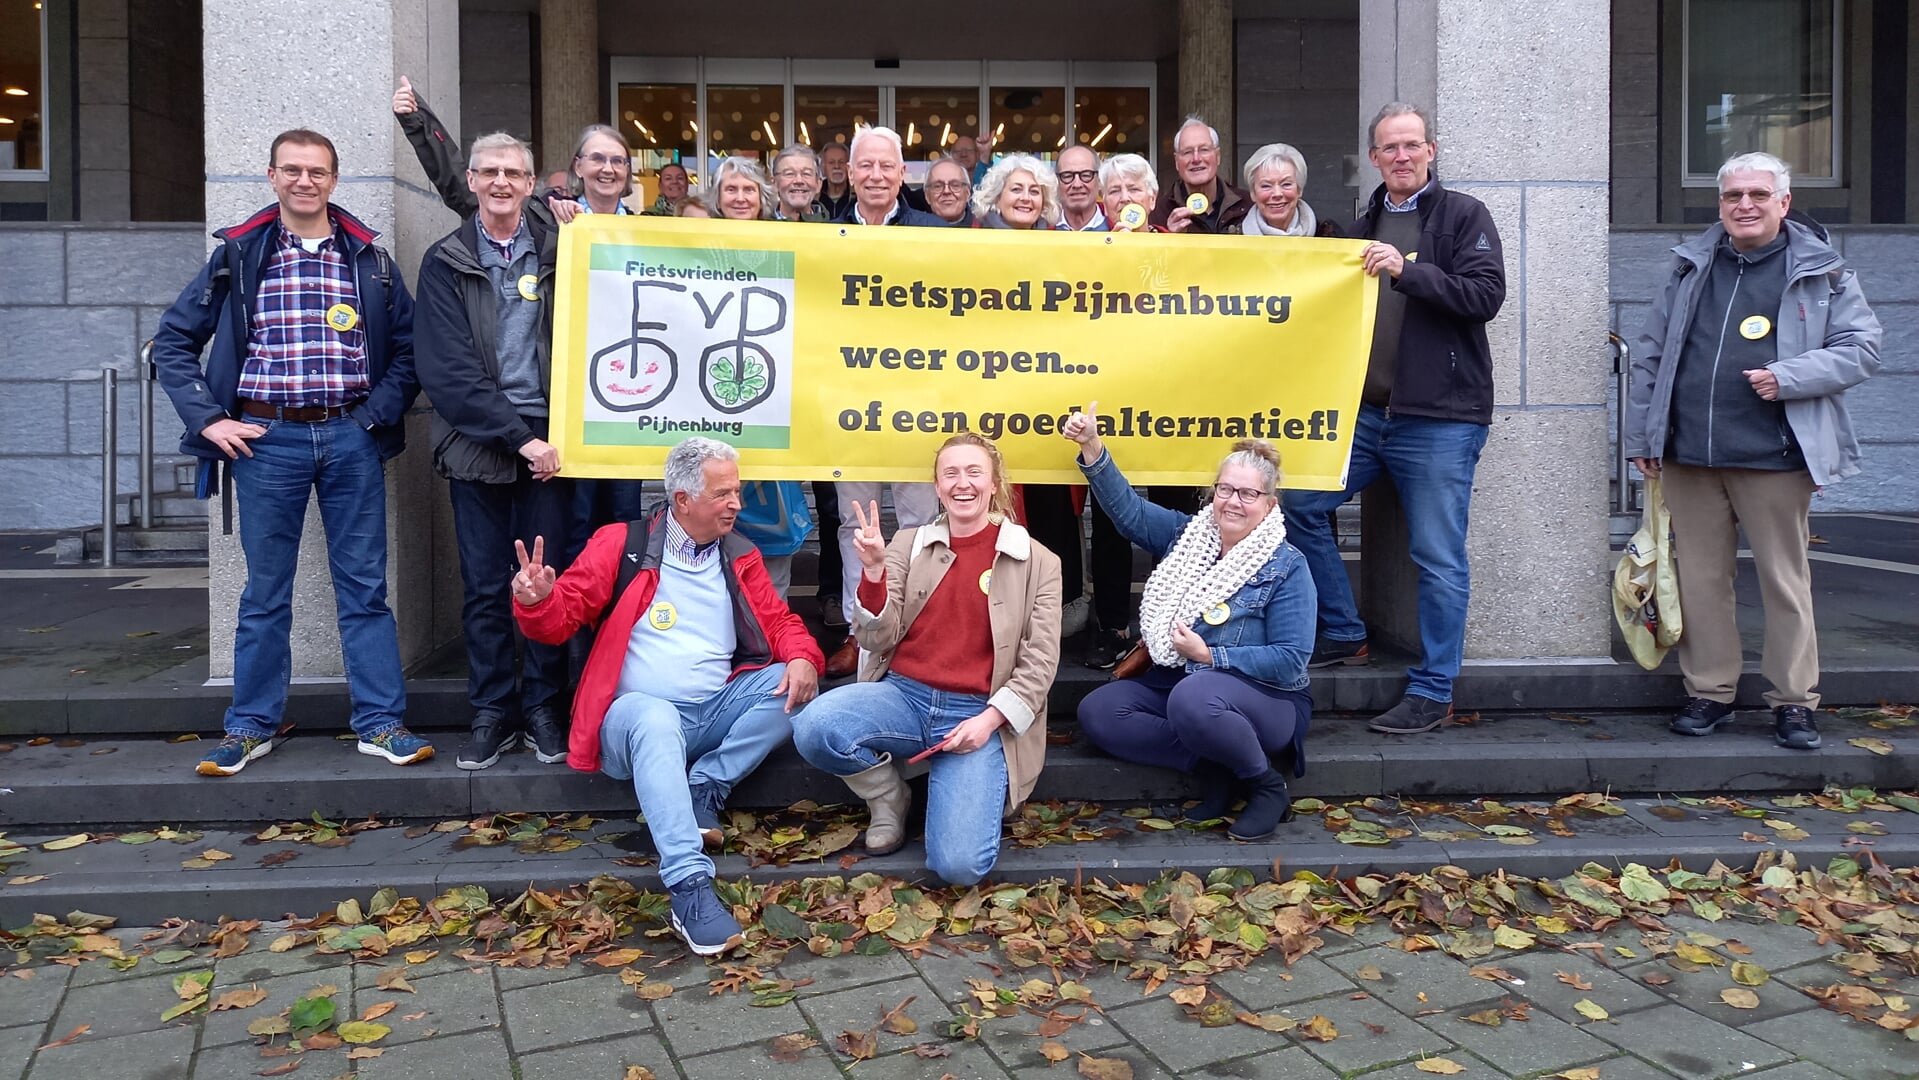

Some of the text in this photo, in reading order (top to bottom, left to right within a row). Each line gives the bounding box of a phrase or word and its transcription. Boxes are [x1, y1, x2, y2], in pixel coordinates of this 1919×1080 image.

[625, 260, 758, 282] Fietsvrienden
[841, 274, 1292, 324] Fietspad Pijnenburg
[839, 346, 1099, 379] weer open...
[637, 415, 744, 436] Pijnenburg
[838, 400, 882, 432] of
[892, 410, 970, 434] een
[1095, 407, 1338, 441] alternatief!
